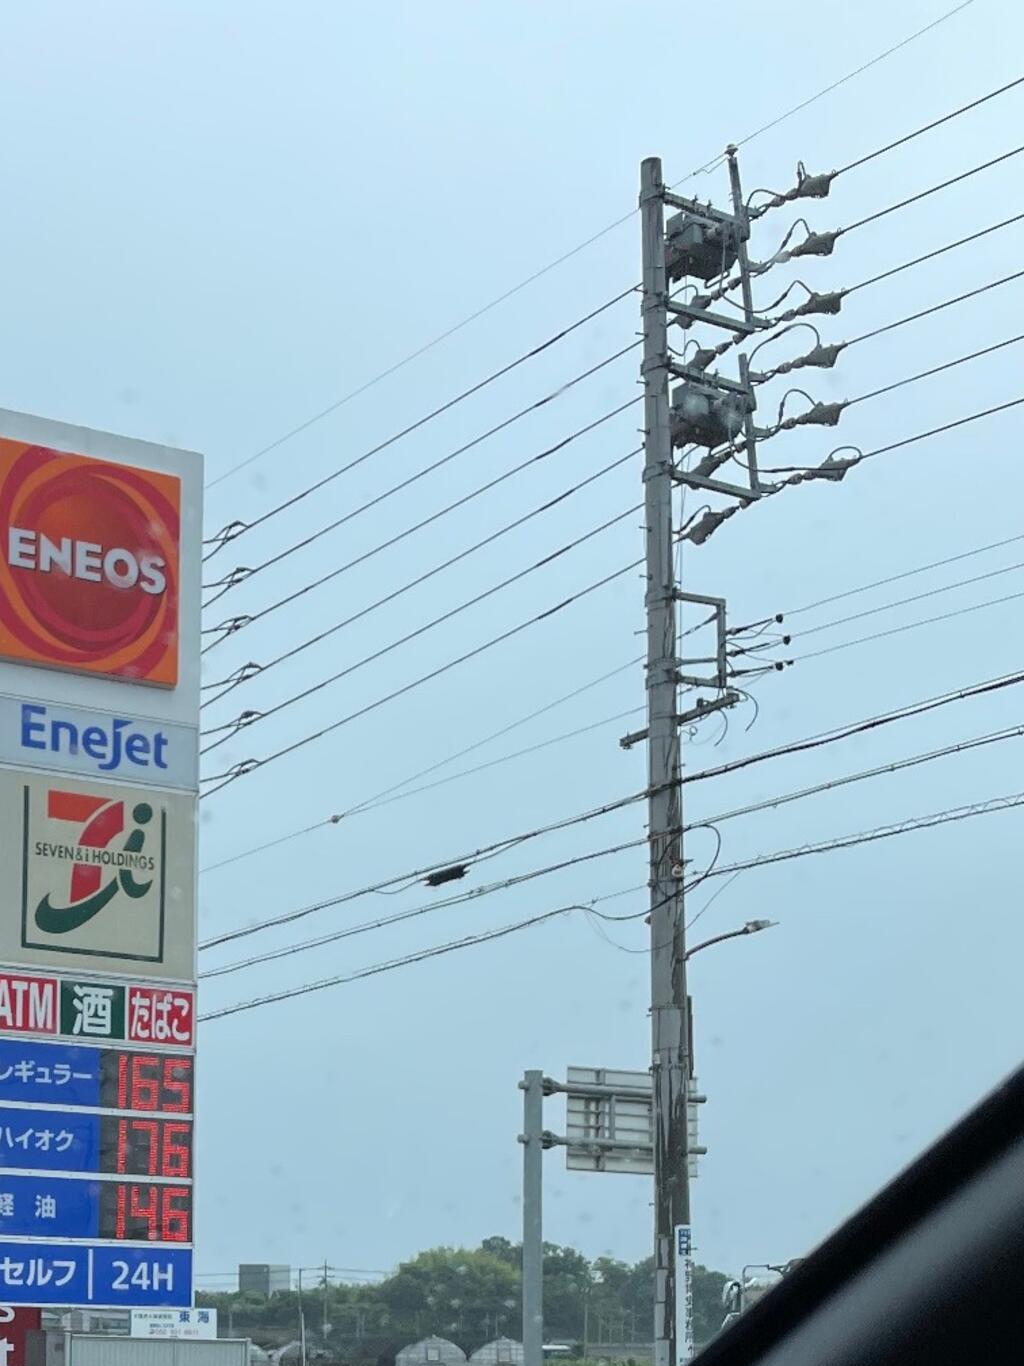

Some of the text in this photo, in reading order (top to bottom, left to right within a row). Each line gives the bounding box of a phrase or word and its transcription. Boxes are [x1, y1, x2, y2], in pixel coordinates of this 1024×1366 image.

[7, 526, 168, 595] ENEOS
[92, 850, 155, 870] HOLDINGS
[72, 984, 113, 1035] 酒
[131, 991, 191, 1041] たばこ
[117, 1054, 191, 1113] 165
[117, 1120, 190, 1178] 176
[116, 1185, 189, 1241] 146
[111, 1260, 173, 1291] 24H
